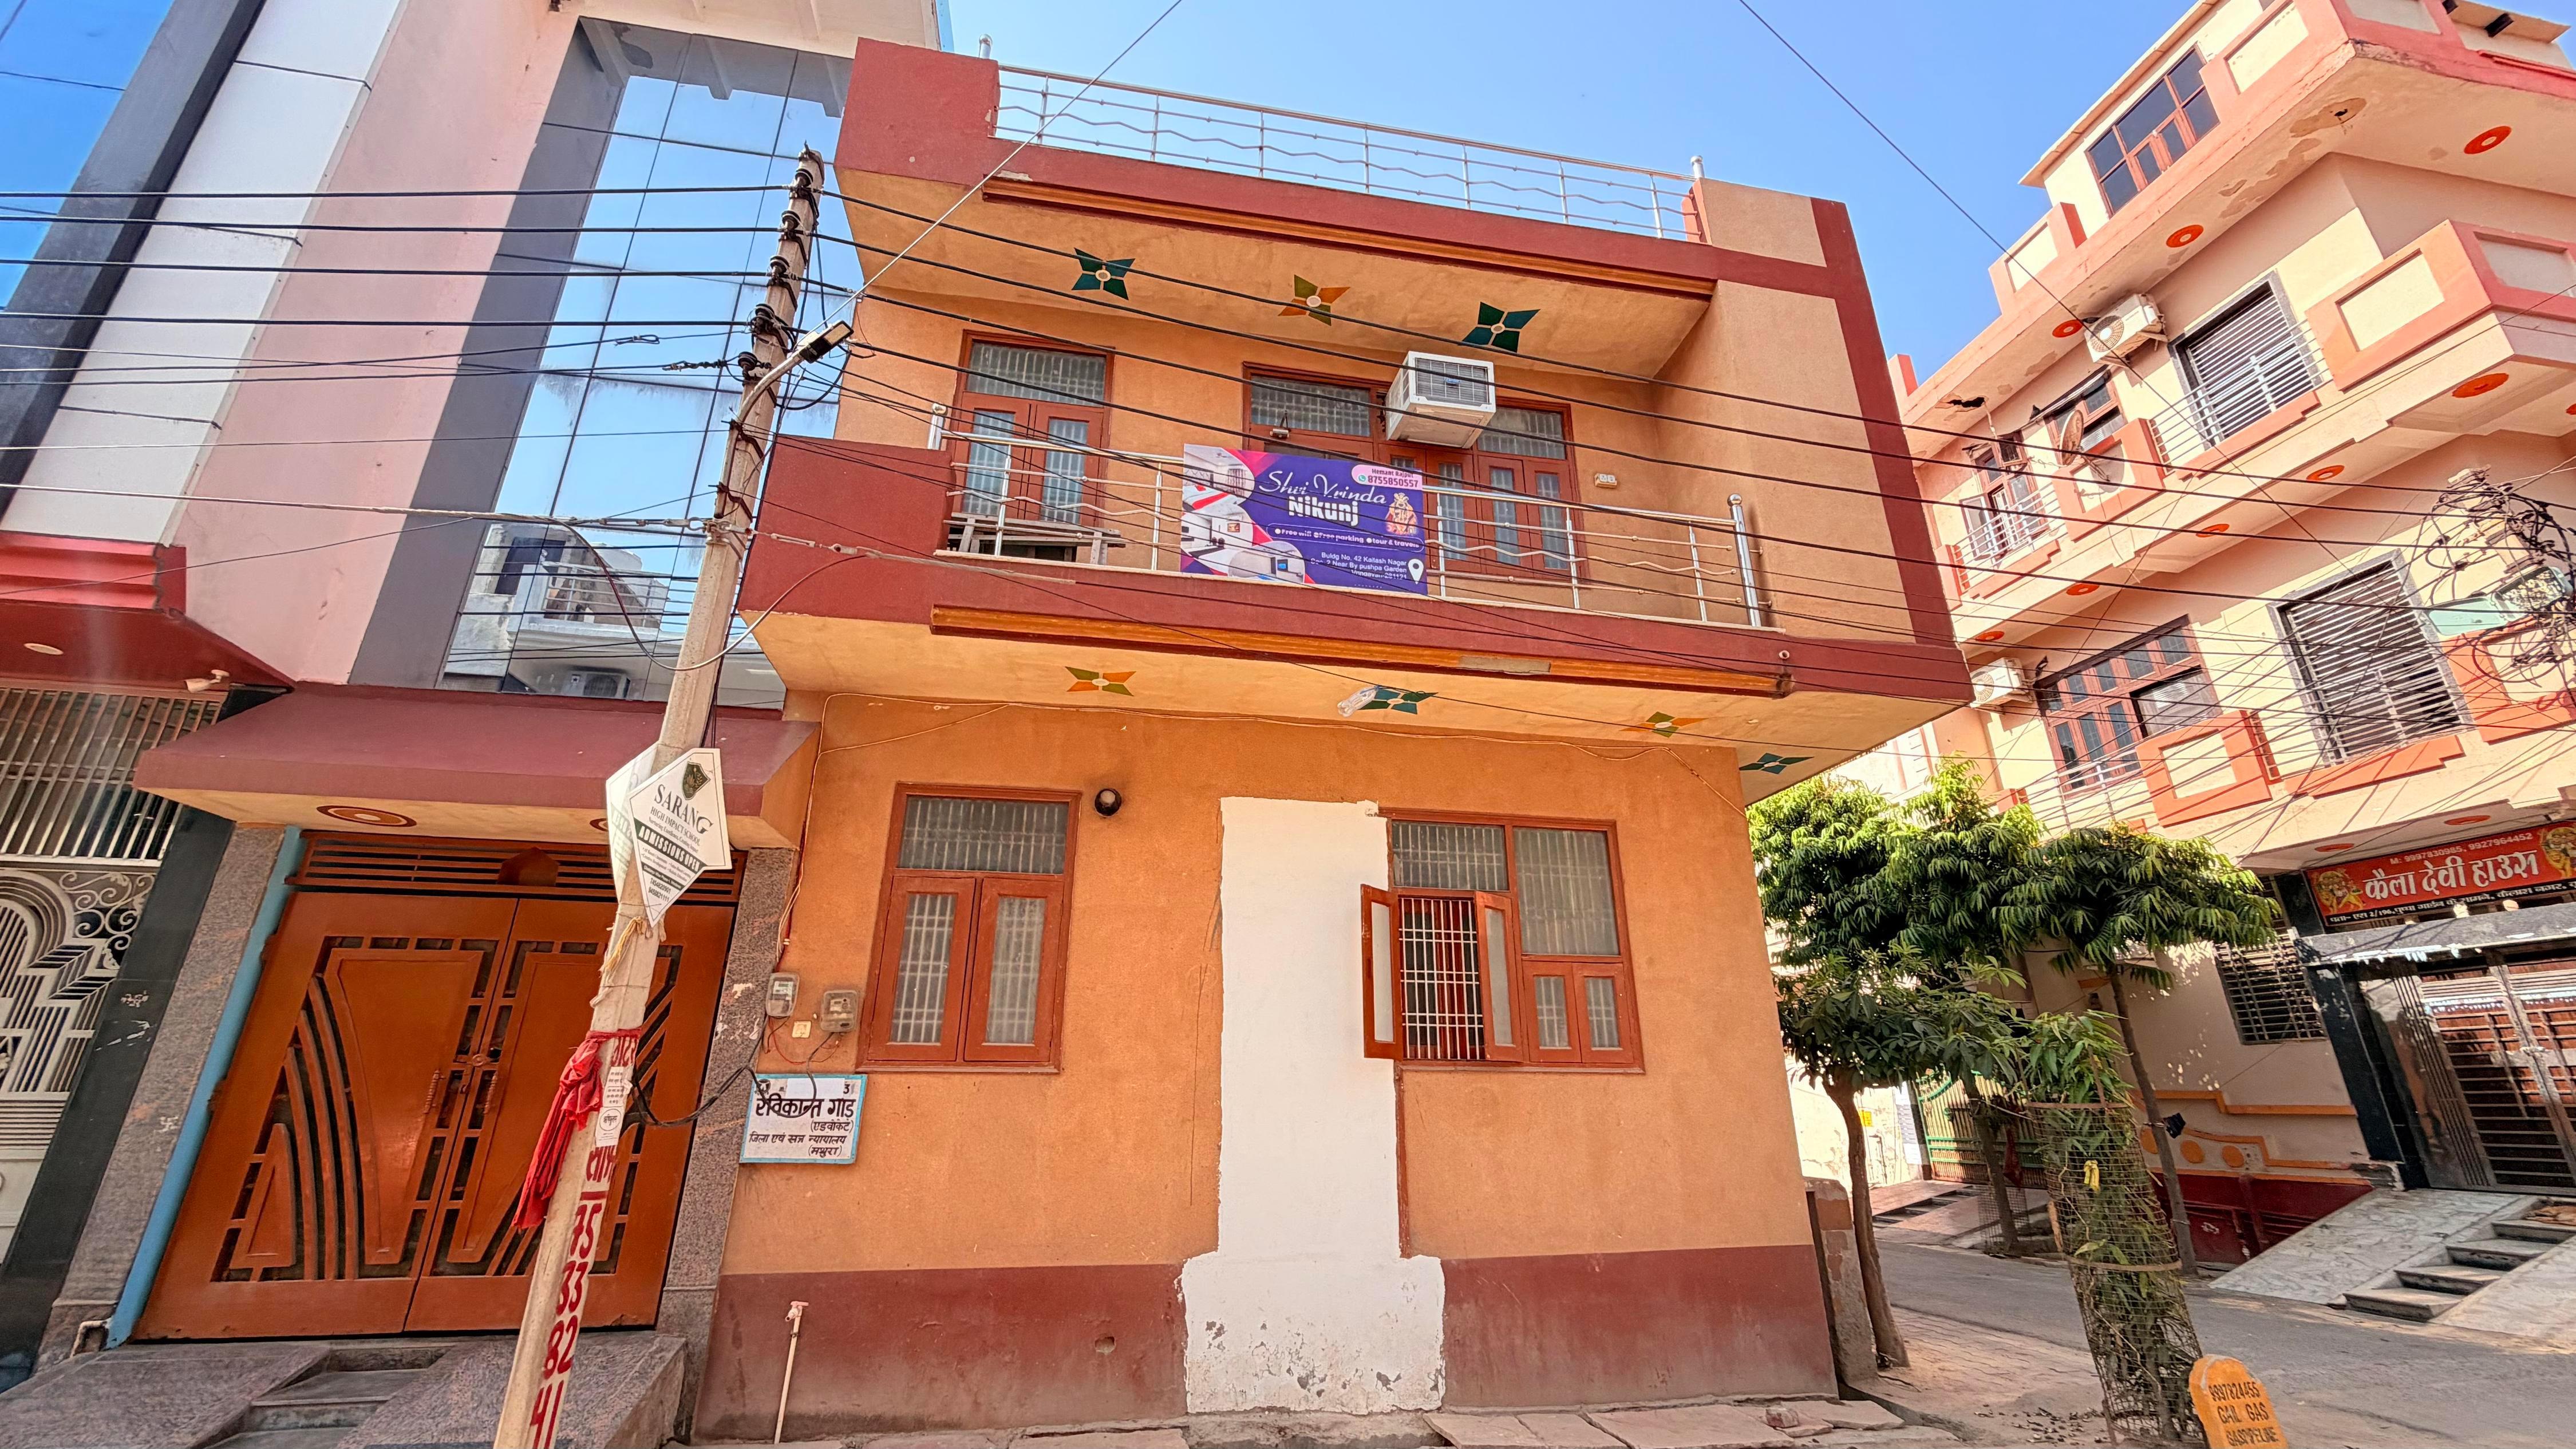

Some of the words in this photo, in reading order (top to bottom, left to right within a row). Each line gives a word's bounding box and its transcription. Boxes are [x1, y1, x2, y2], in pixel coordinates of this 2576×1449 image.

[1259, 471, 1309, 495] Shri
[1313, 474, 1386, 504] Vrinda
[1368, 475, 1419, 488] 8755850557
[1289, 496, 1358, 526] Nikunj
[1336, 535, 1364, 543] parking
[1394, 540, 1420, 548] travels
[1321, 552, 1340, 560] Buldg
[1388, 558, 1407, 567] Nagar
[1359, 564, 1382, 572] pushpa
[654, 784, 714, 834] SARANG
[650, 806, 666, 822] HIGH
[665, 815, 685, 834] IMPACT
[684, 828, 700, 846] SCHOOL
[2468, 832, 2534, 850] 9927964452
[638, 825, 685, 862] ADMISSIONS
[684, 853, 701, 872] OPEN
[2362, 867, 2417, 901] कैला
[2419, 855, 2466, 896] देवी
[2468, 850, 2539, 888] हाउस
[748, 1131, 771, 1143] जिला
[771, 1132, 786, 1143] एवं
[808, 1134, 848, 1144] न्यायालय
[808, 1144, 843, 1158] (मथुरा)
[570, 1203, 602, 1260] 75
[555, 1261, 588, 1316] 33
[543, 1314, 578, 1380] 82
[530, 1380, 564, 1449] 41
[2245, 1401, 2269, 1421] GAS
